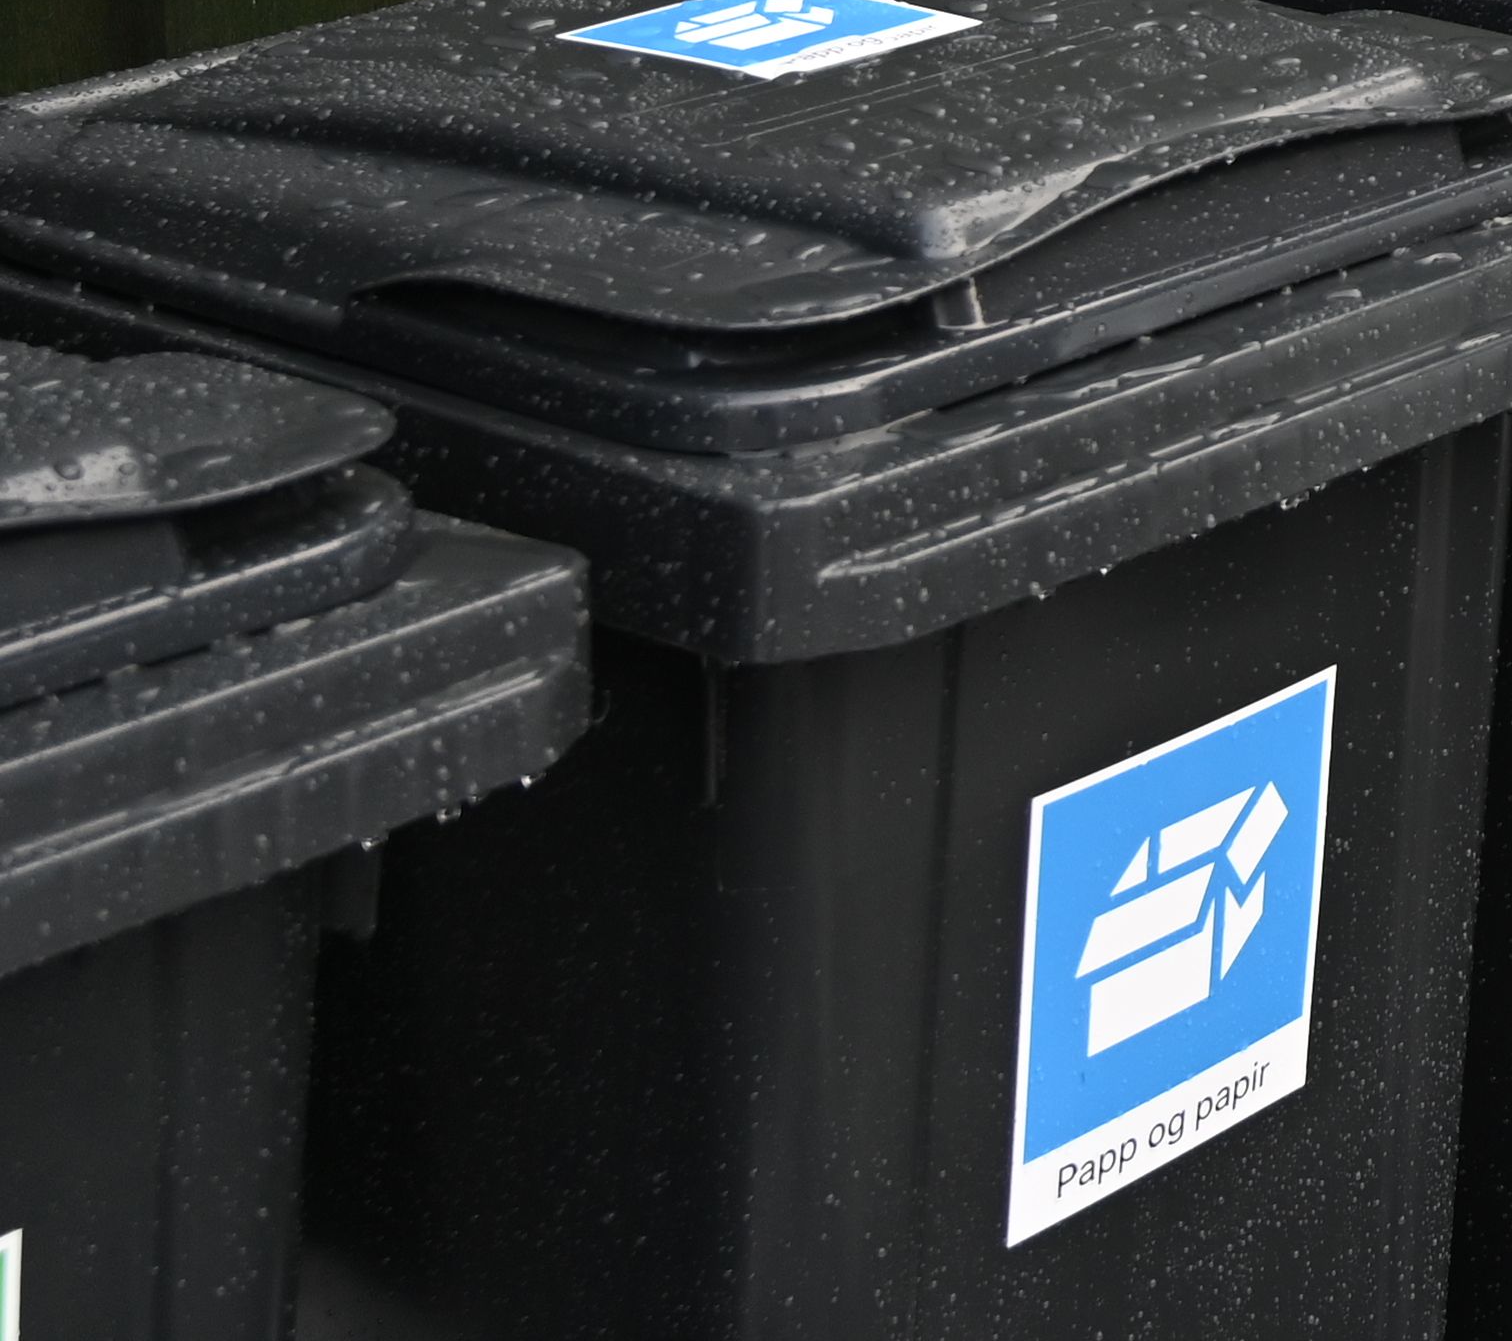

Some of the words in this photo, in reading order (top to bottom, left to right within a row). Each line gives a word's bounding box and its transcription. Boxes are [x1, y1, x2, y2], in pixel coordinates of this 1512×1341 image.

[1056, 1136, 1137, 1199] Papp
[1147, 1108, 1186, 1146] og
[1195, 1060, 1271, 1131] papir
